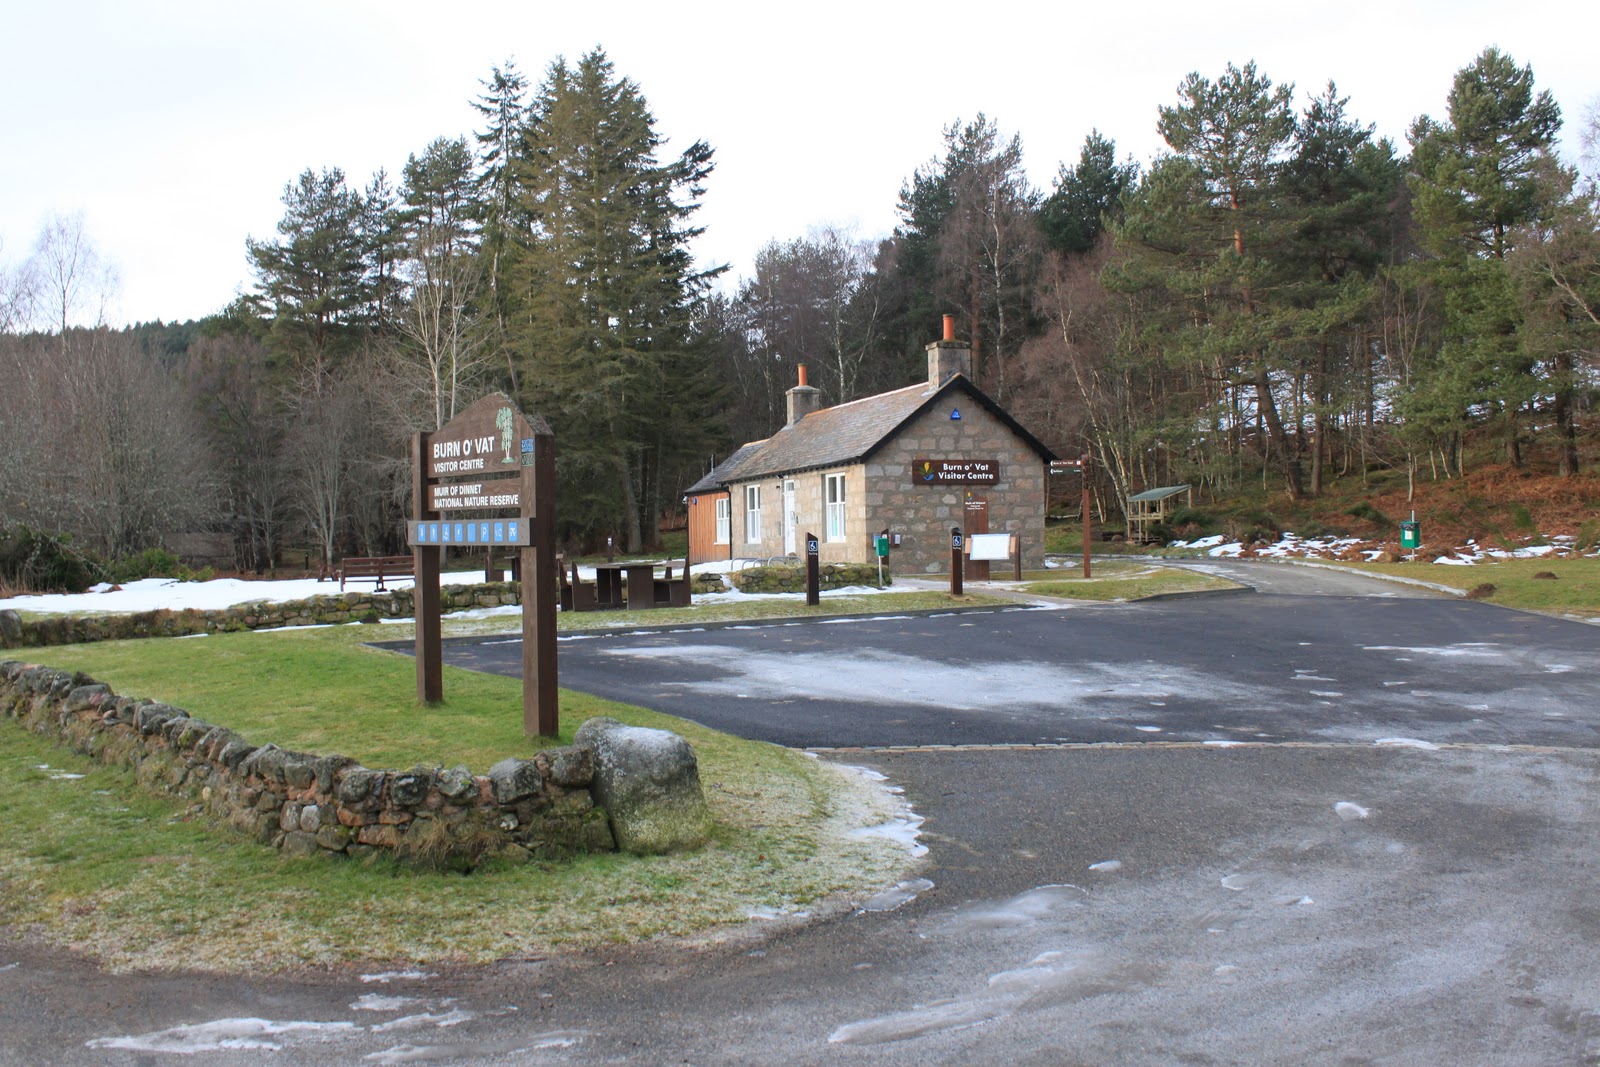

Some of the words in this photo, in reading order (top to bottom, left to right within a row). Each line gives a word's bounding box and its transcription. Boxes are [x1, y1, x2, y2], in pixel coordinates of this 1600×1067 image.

[433, 441, 460, 458] BURN
[475, 436, 495, 454] VAT
[434, 461, 458, 473] VISITOR
[460, 458, 484, 471] CENTRE
[943, 463, 963, 471] Burn
[975, 463, 989, 471] Vat
[938, 472, 966, 480] Visitor
[967, 472, 994, 480] Centre
[434, 486, 449, 497] MUIR
[450, 485, 459, 496] OF
[459, 484, 482, 495] DINNET
[434, 497, 463, 508] NATIONAL
[464, 496, 489, 507] NATURE
[490, 494, 519, 506] RESERVE
